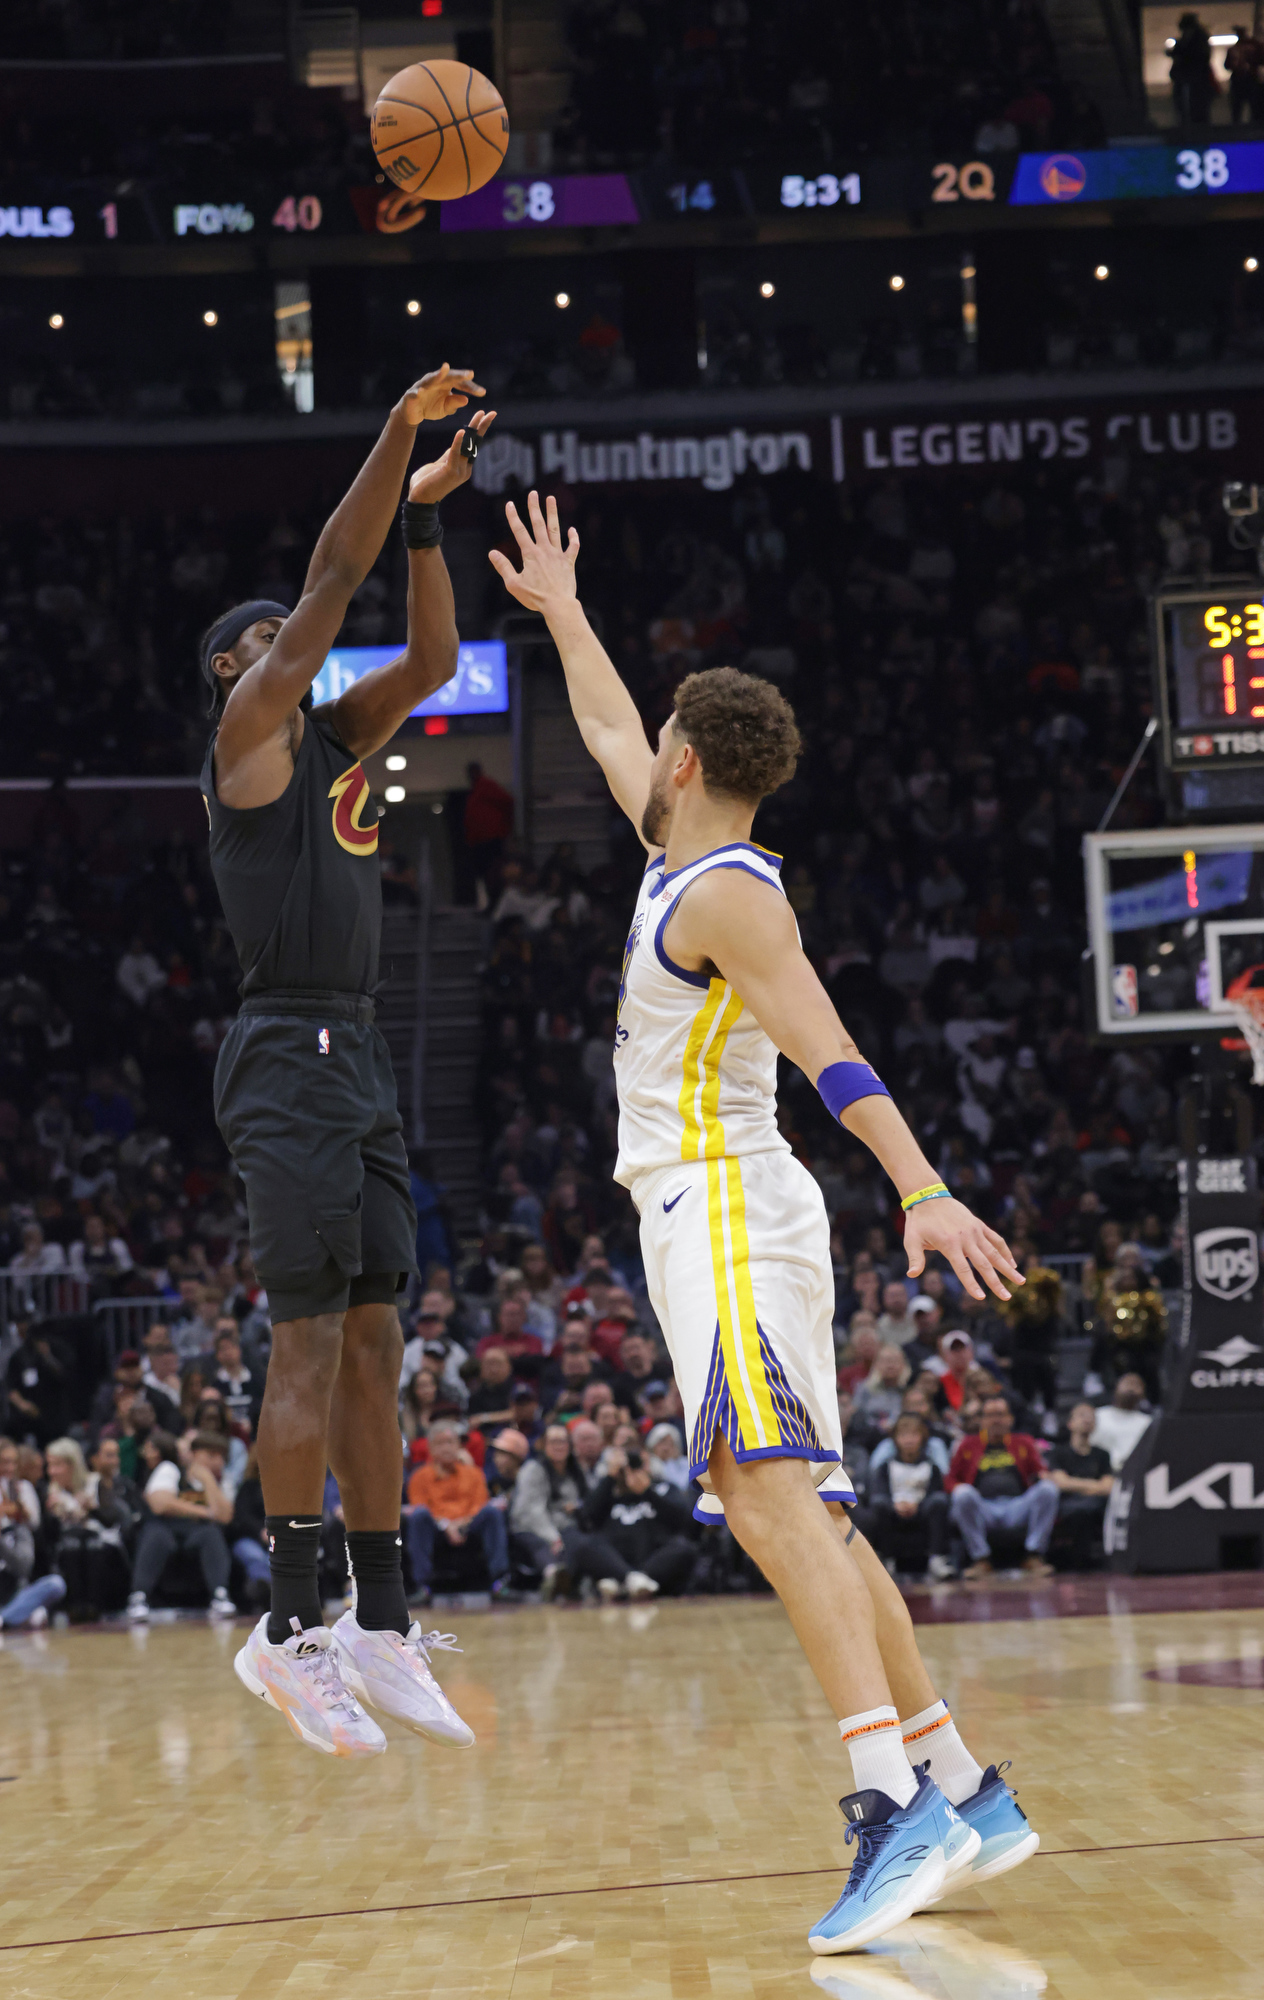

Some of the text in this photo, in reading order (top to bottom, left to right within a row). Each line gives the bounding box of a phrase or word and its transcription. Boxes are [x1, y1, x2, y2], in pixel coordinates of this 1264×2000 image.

[931, 161, 996, 202] 2Q
[1176, 148, 1230, 190] 38
[502, 181, 555, 222] 38
[667, 180, 716, 212] 14
[780, 172, 861, 208] 5:31
[101, 202, 118, 239] 1
[173, 195, 322, 236] FG% 40
[540, 428, 812, 491] Huntington
[862, 417, 1090, 469] LEGENDS
